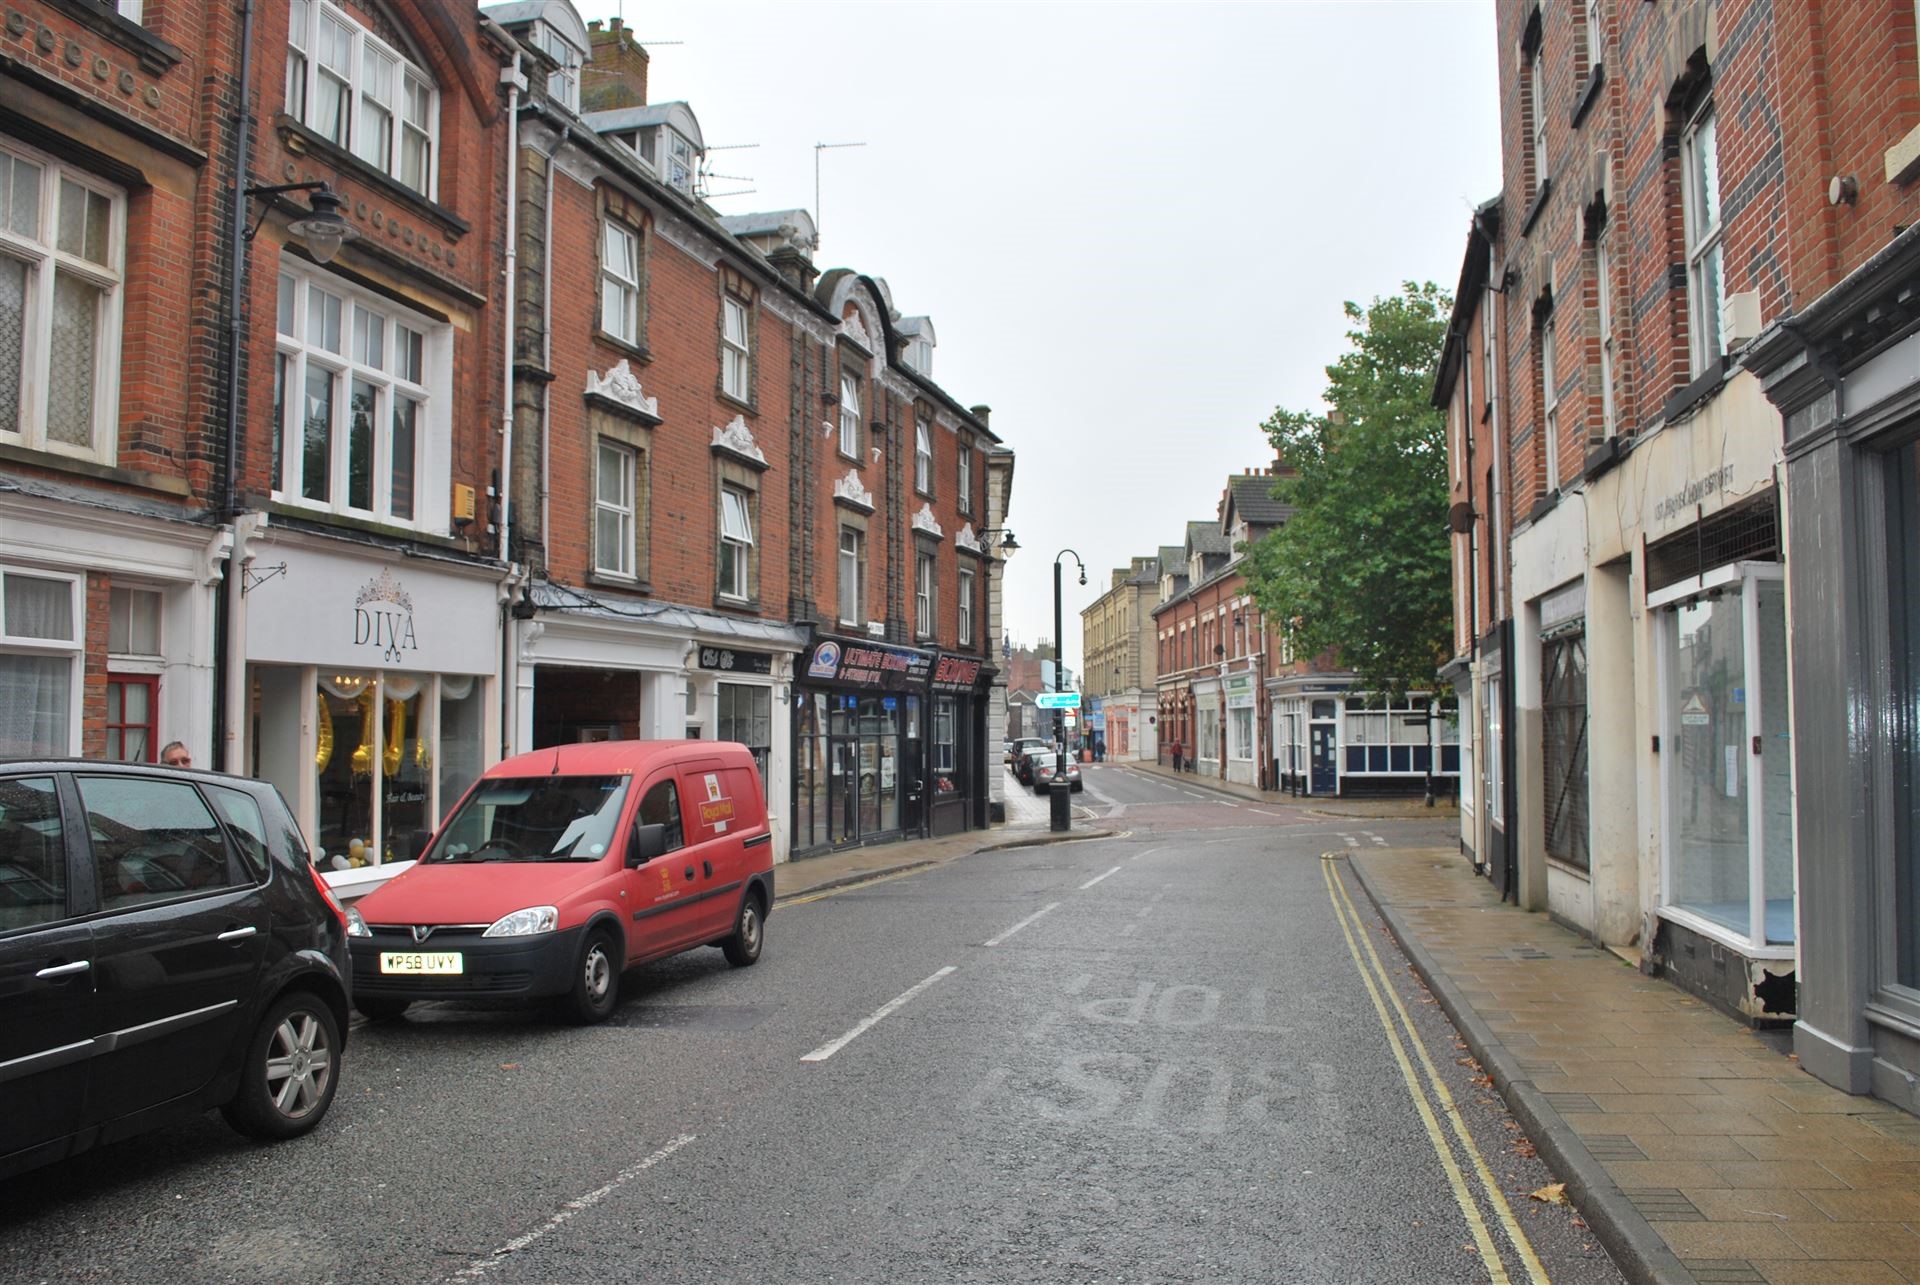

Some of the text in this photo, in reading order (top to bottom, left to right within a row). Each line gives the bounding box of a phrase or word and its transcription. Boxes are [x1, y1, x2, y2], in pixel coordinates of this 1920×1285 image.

[353, 608, 418, 662] DIVA
[844, 647, 883, 668] ULTIMATE
[934, 656, 980, 684] BOXING
[702, 800, 733, 821] Royal Mail
[427, 955, 455, 969] UVY
